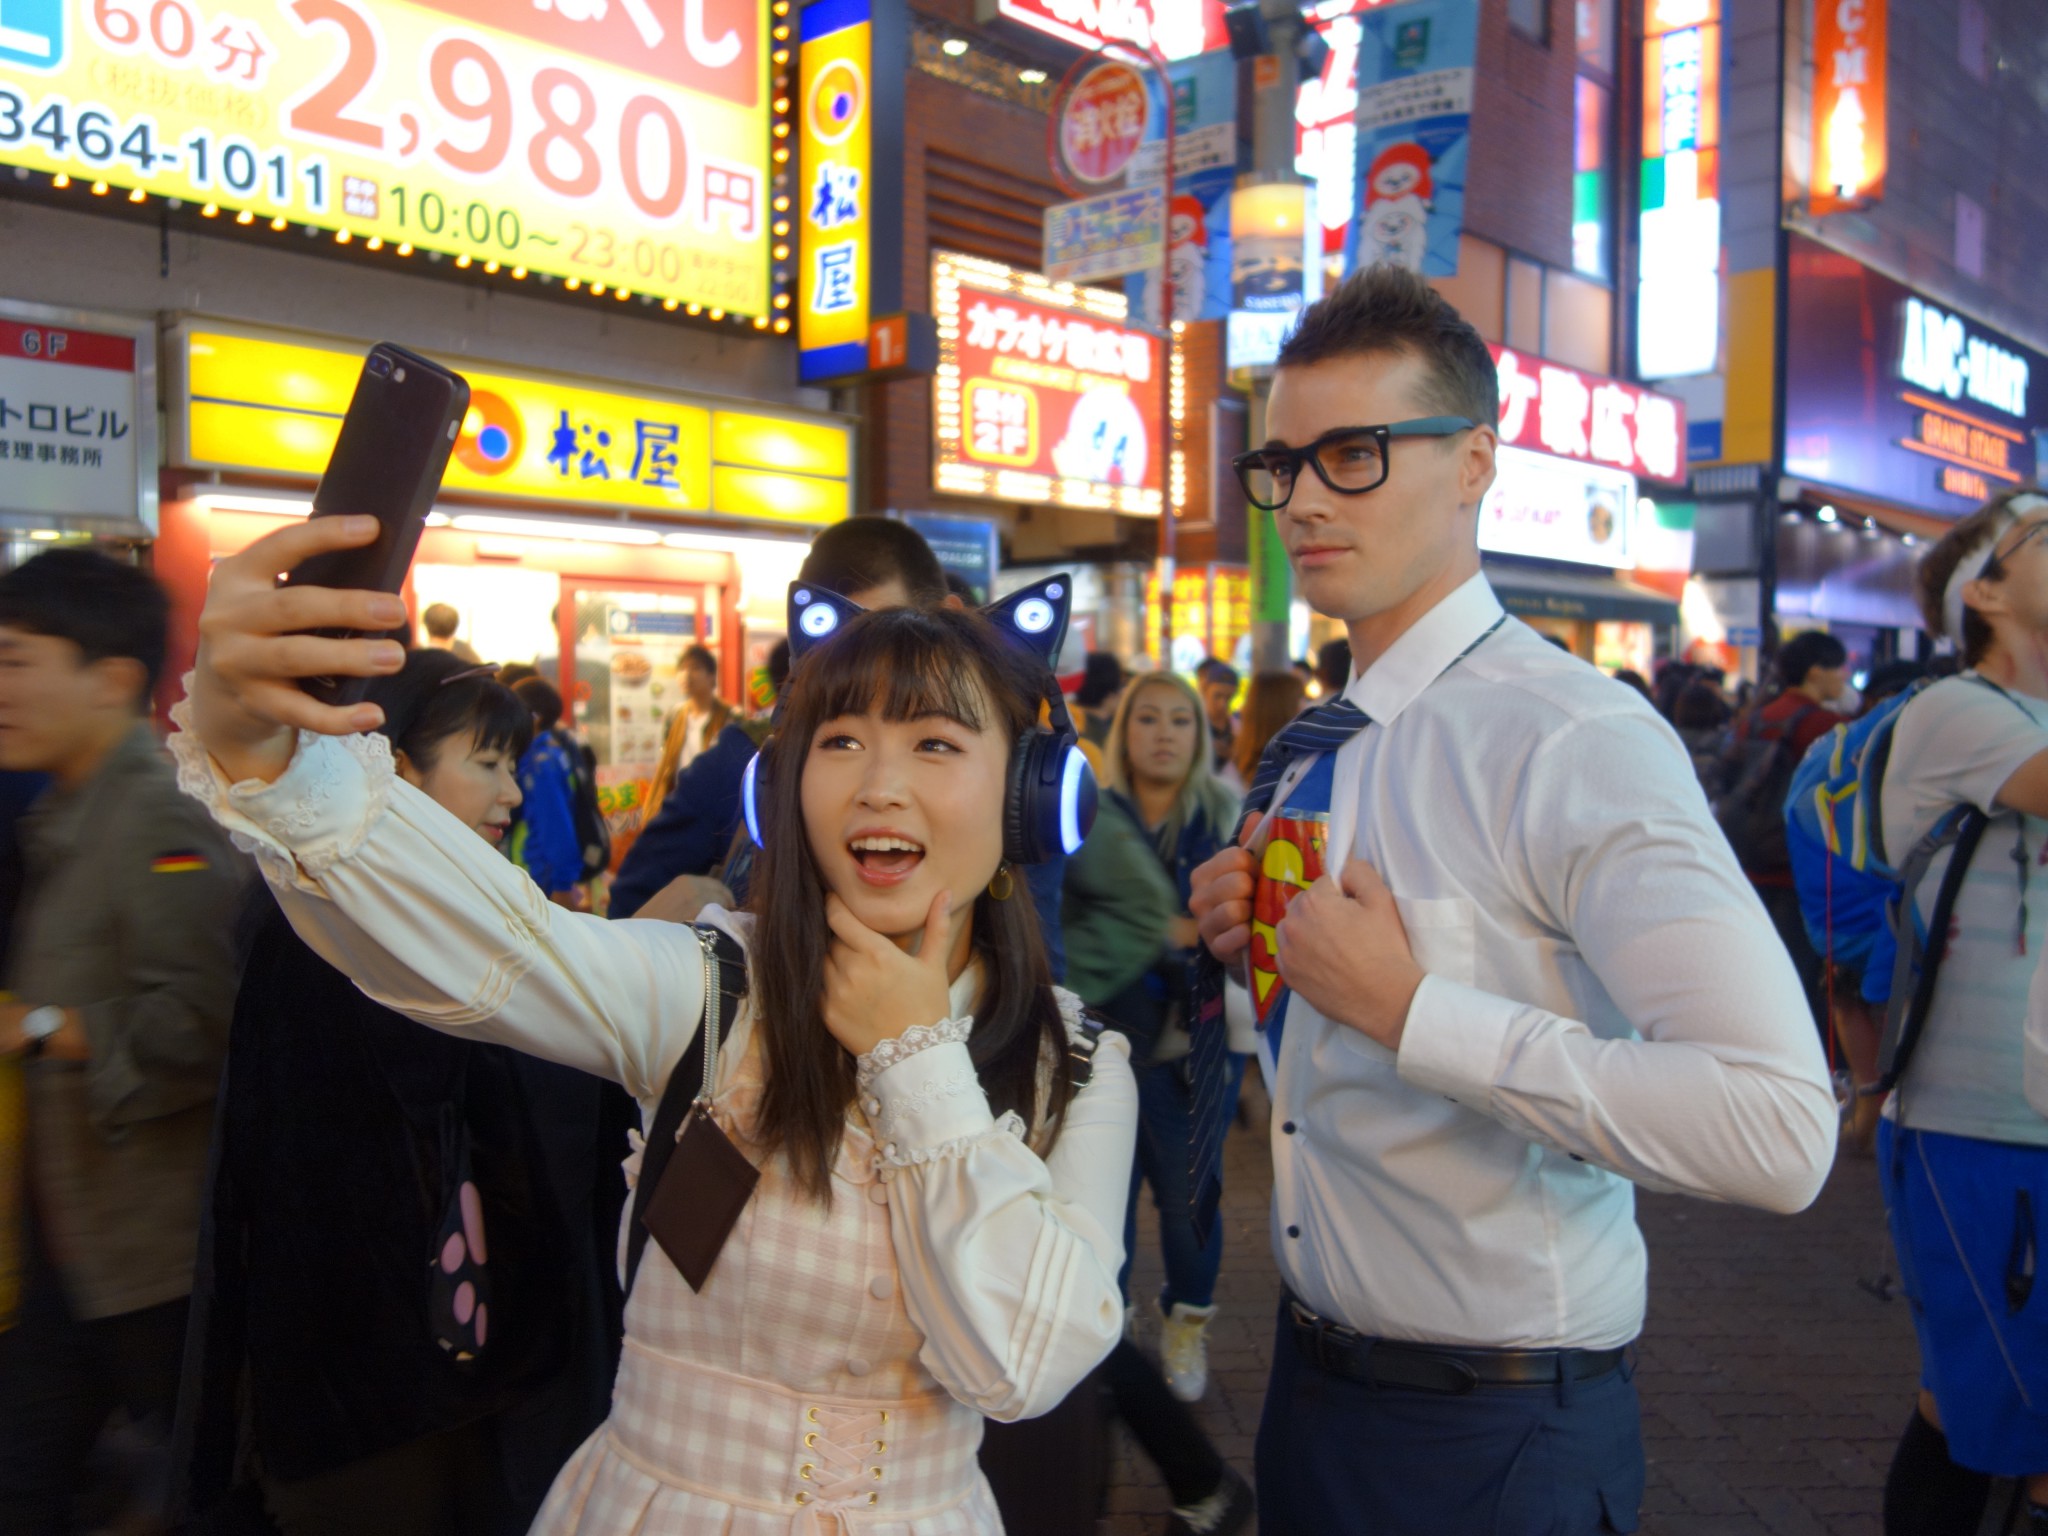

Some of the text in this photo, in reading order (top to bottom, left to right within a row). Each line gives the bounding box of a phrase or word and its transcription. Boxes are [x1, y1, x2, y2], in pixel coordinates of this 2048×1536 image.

[811, 166, 857, 311] 松屋
[23, 329, 67, 356] 6F
[546, 409, 682, 491] 松屋
[974, 421, 1027, 455] 2F
